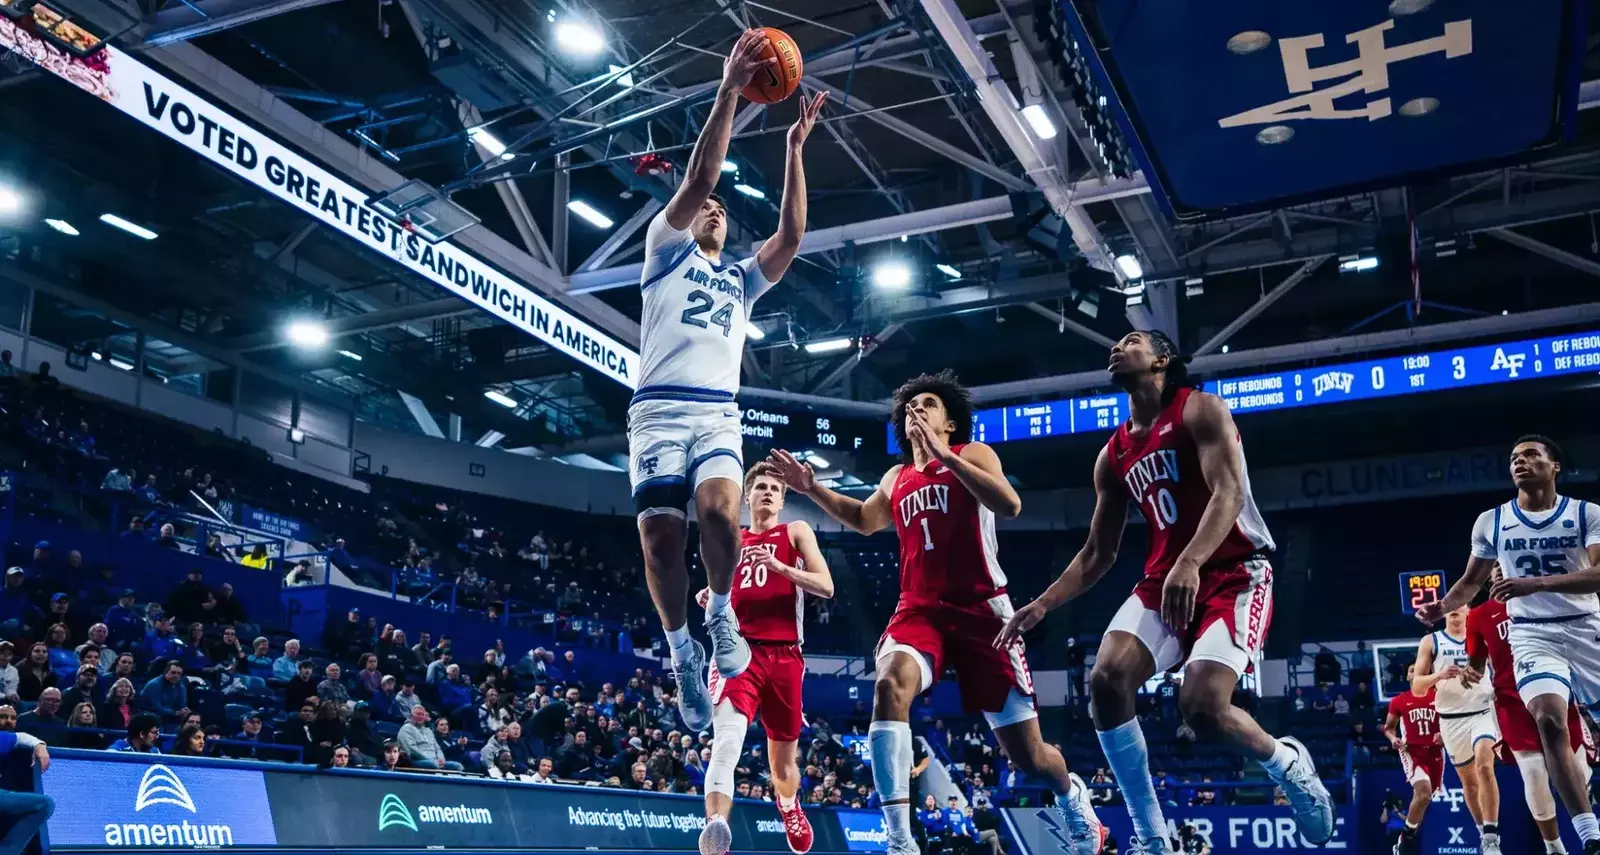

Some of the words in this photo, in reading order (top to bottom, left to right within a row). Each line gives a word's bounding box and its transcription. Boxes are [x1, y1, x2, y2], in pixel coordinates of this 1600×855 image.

[143, 81, 258, 170] VOTED
[264, 156, 402, 251] GREATEST
[406, 230, 526, 321] SANDWICH
[530, 304, 549, 334] IN
[553, 319, 629, 379] AMERICA
[683, 267, 710, 287] AIR
[681, 289, 735, 338] 24
[1534, 343, 1539, 356] 1
[1552, 340, 1569, 353] OFF
[1571, 335, 1600, 350] REBOU
[1402, 355, 1430, 370] 19:00
[1452, 356, 1466, 379] 3
[1490, 347, 1526, 378] AF
[1534, 360, 1542, 373] 0
[1554, 355, 1571, 370] DEF
[1573, 352, 1600, 367] REBO
[1222, 382, 1238, 395] OFF
[1238, 376, 1283, 393] REBOUNDS
[1294, 373, 1302, 386] 0
[1312, 371, 1354, 396] UNLV
[1371, 366, 1385, 390] 0
[1409, 373, 1426, 387] 1ST
[1240, 392, 1284, 408] REBOUNDS
[1296, 389, 1303, 402] 0
[747, 409, 789, 424] Orleans
[816, 418, 830, 430] 56
[741, 425, 773, 438] derbilt
[817, 433, 836, 446] 100
[854, 437, 862, 449] F
[1124, 449, 1180, 504] UNLV
[1301, 462, 1418, 499] CLUNE
[899, 484, 949, 528] UNLV
[1148, 487, 1179, 531] 10
[921, 517, 934, 551] 1
[1504, 538, 1527, 551] AIR
[1529, 536, 1578, 550] FORCE
[740, 564, 768, 589] 20
[1409, 574, 1440, 589] 19:00
[1411, 588, 1438, 609] 27
[1247, 566, 1273, 652] REBELS
[1408, 707, 1436, 723] UNLV
[1418, 720, 1430, 736] 11
[418, 804, 492, 825] amentum
[568, 806, 626, 830] Advancing
[623, 809, 642, 828] the
[641, 809, 672, 829] future
[104, 819, 233, 846] amentum
[756, 818, 787, 833] amentu
[1448, 827, 1465, 844] X
